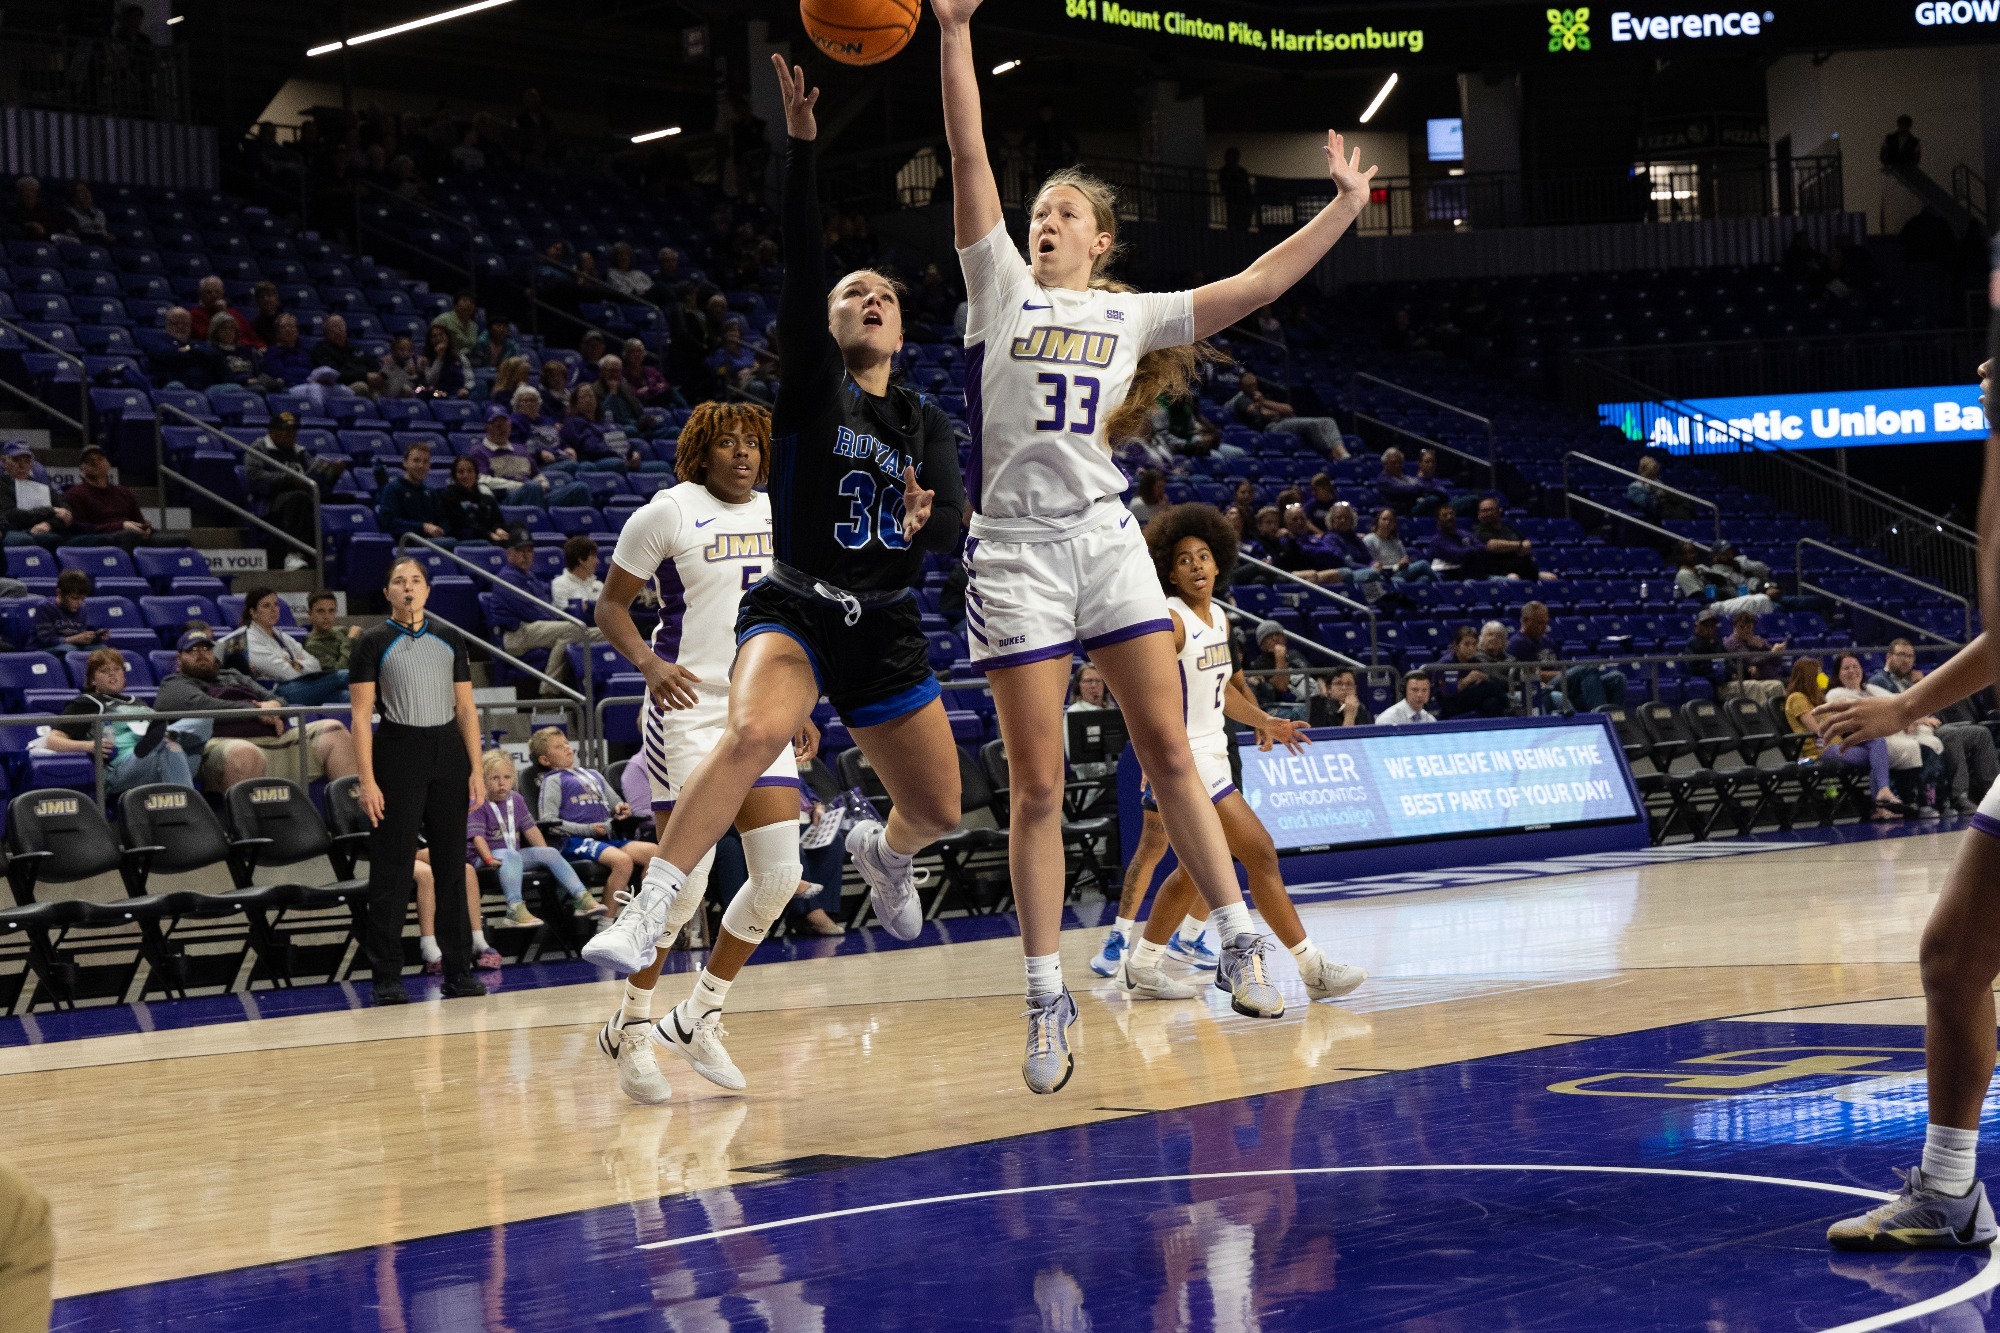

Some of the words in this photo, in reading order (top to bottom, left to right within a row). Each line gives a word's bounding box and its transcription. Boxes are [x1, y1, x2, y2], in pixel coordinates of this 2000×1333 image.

[1065, 0, 1097, 21] 841
[1102, 1, 1161, 32] Mount
[1163, 11, 1225, 42] Clinton
[1228, 21, 1267, 51] Pike,
[1270, 26, 1424, 52] Harrisonburg
[1915, 0, 2000, 26] GROW
[1010, 325, 1119, 369] JMU
[1035, 371, 1101, 435] 33
[1811, 405, 1926, 438] Union
[1933, 401, 1992, 432] Ba
[834, 469, 912, 551] 30
[228, 555, 263, 569] YOU!
[999, 634, 1026, 648] DUKES
[1214, 672, 1225, 709] 2
[1258, 753, 1360, 787] WEILER
[1383, 756, 1417, 779] WE
[1416, 751, 1491, 777] BELIEVE
[1489, 750, 1512, 772] IN
[1511, 746, 1567, 771] BEING
[1565, 744, 1603, 766] THE
[35, 799, 79, 816] JMU
[145, 792, 188, 810] JMU
[250, 786, 290, 803] JMU
[1269, 785, 1367, 808] ORTHODONTICS
[1400, 792, 1446, 817] BEST
[1446, 788, 1494, 812] PART
[1495, 786, 1520, 809] OF
[1520, 782, 1573, 805] YOUR
[1571, 779, 1614, 802] DAY!
[1277, 810, 1309, 830] and
[1307, 805, 1376, 829] invisalign
